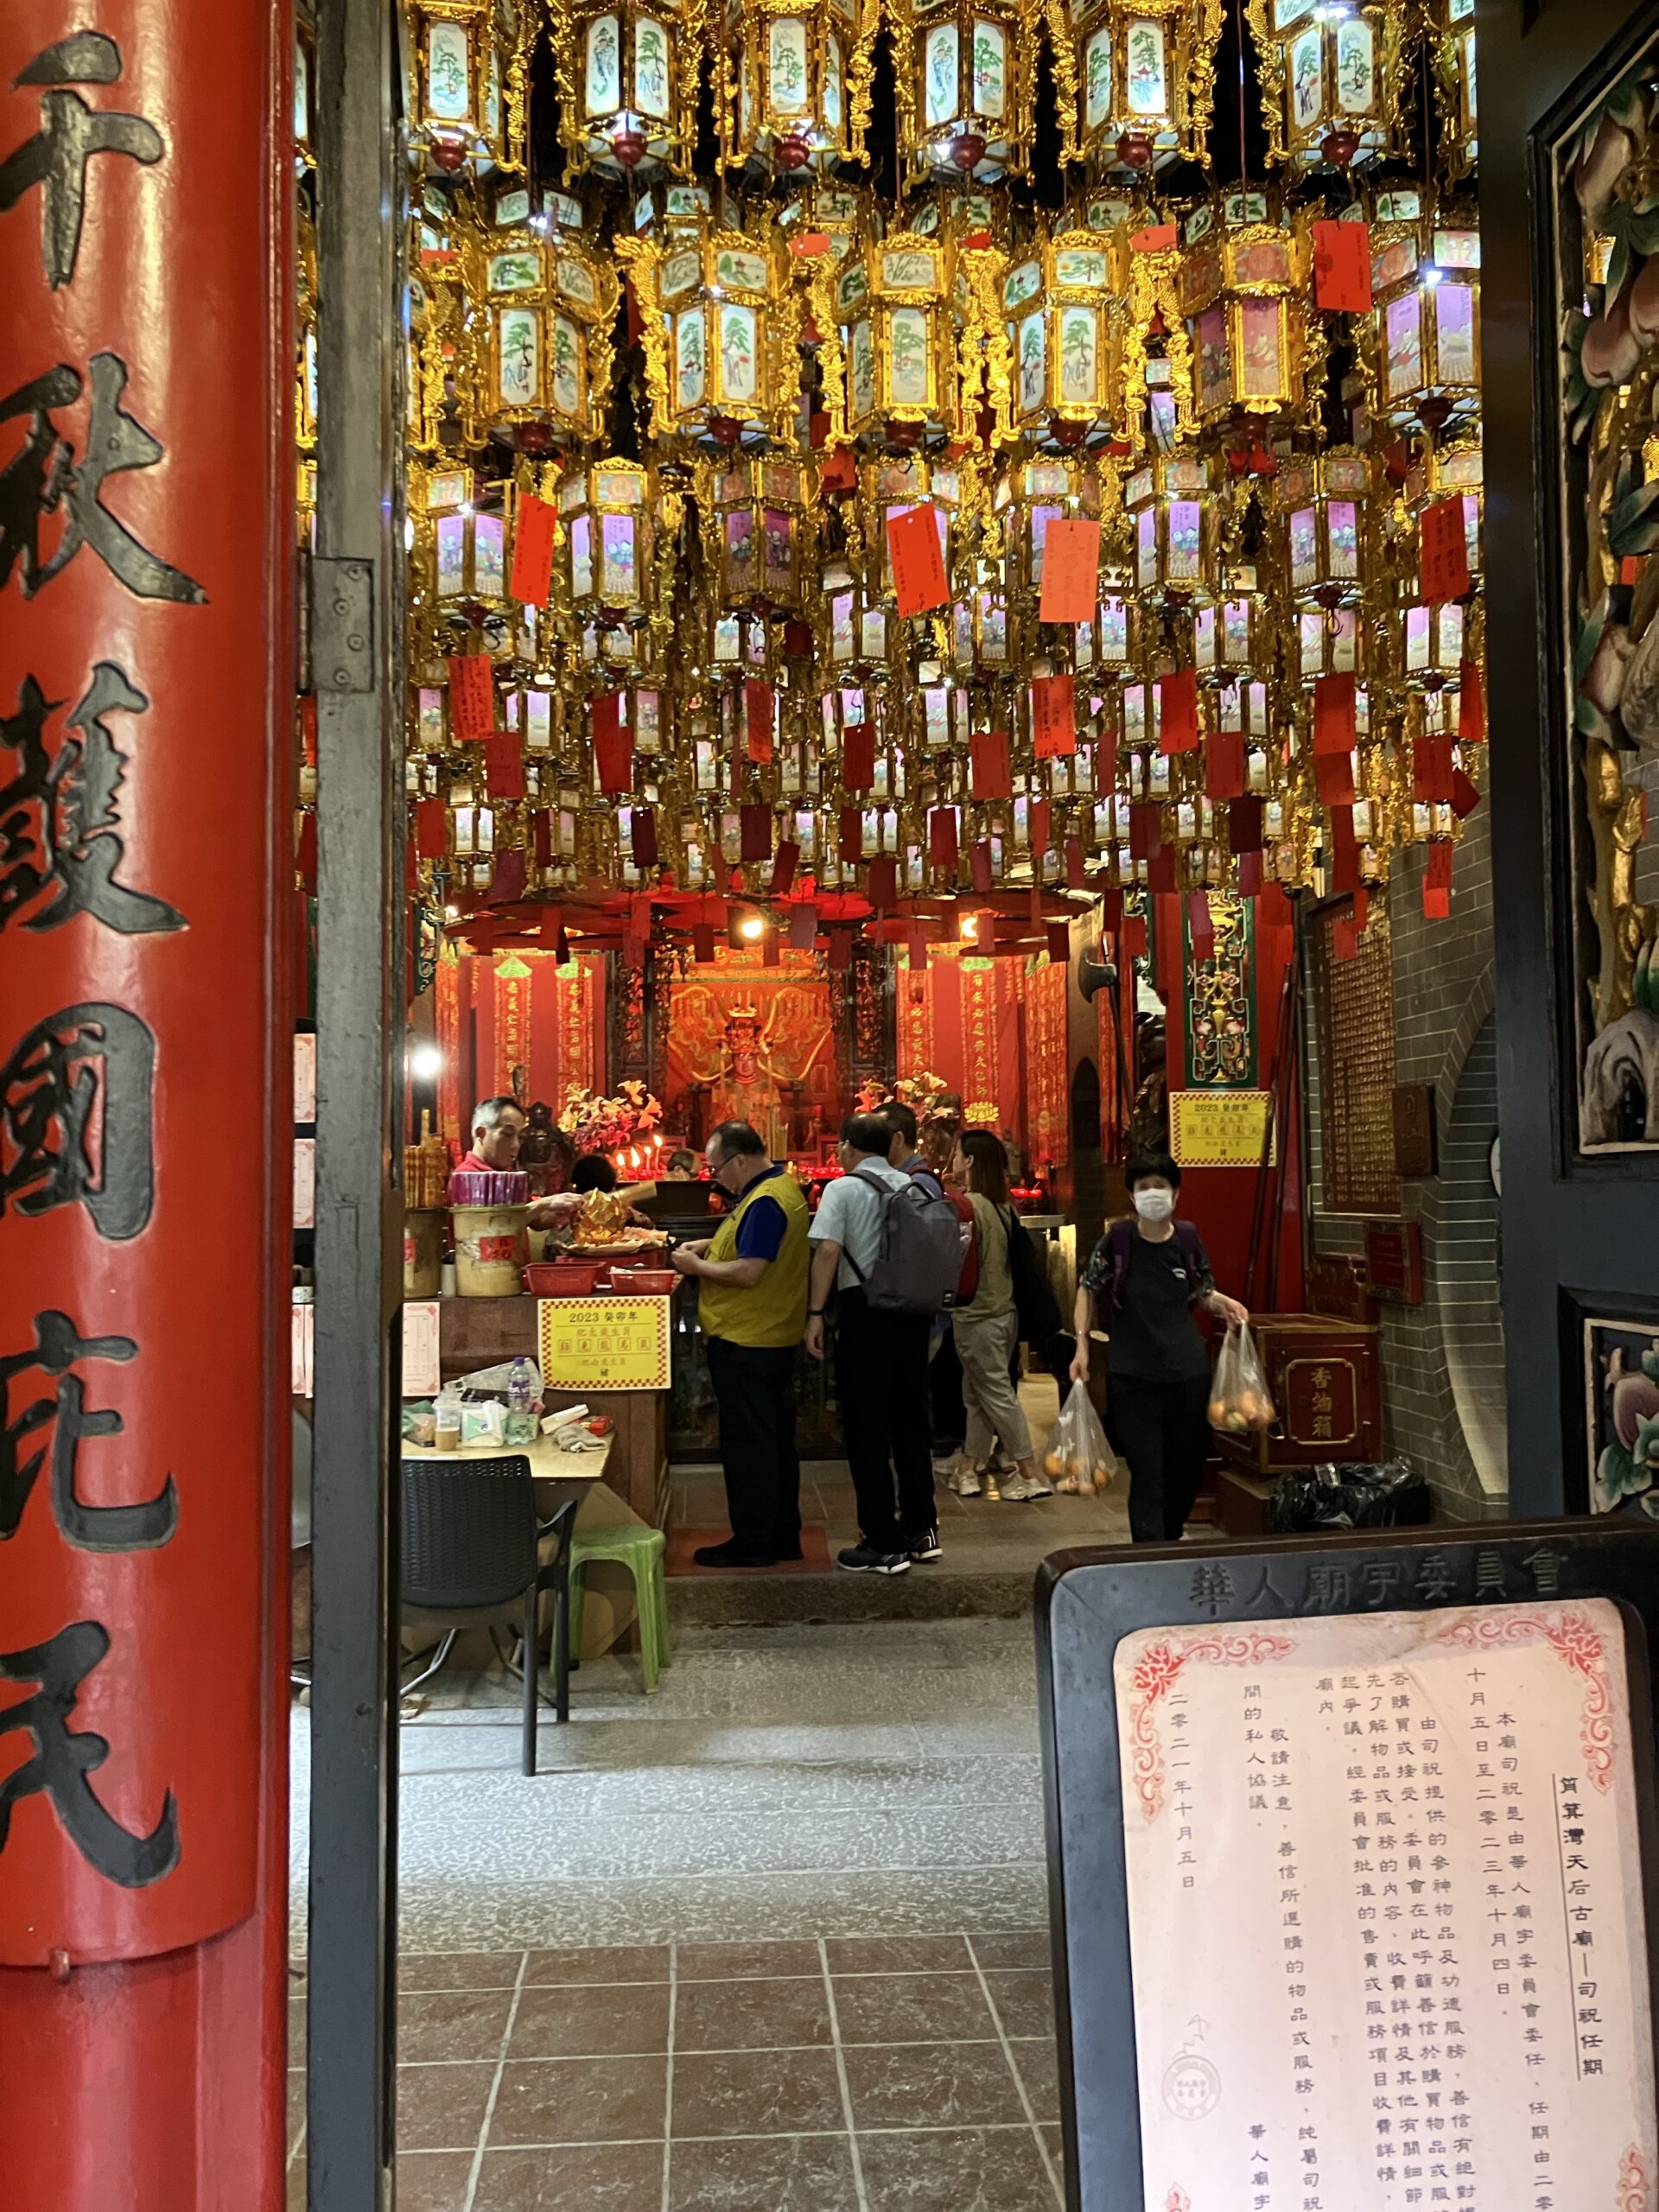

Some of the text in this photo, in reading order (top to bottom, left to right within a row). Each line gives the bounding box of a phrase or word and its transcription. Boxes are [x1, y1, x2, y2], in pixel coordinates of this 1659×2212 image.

[569, 1312, 600, 1323] 2023
[1311, 1366, 1332, 1438] 香油箱
[1189, 1548, 1566, 1616] 華人廟宇委員會
[1168, 1694, 1198, 1888] 二零二一年十月五日
